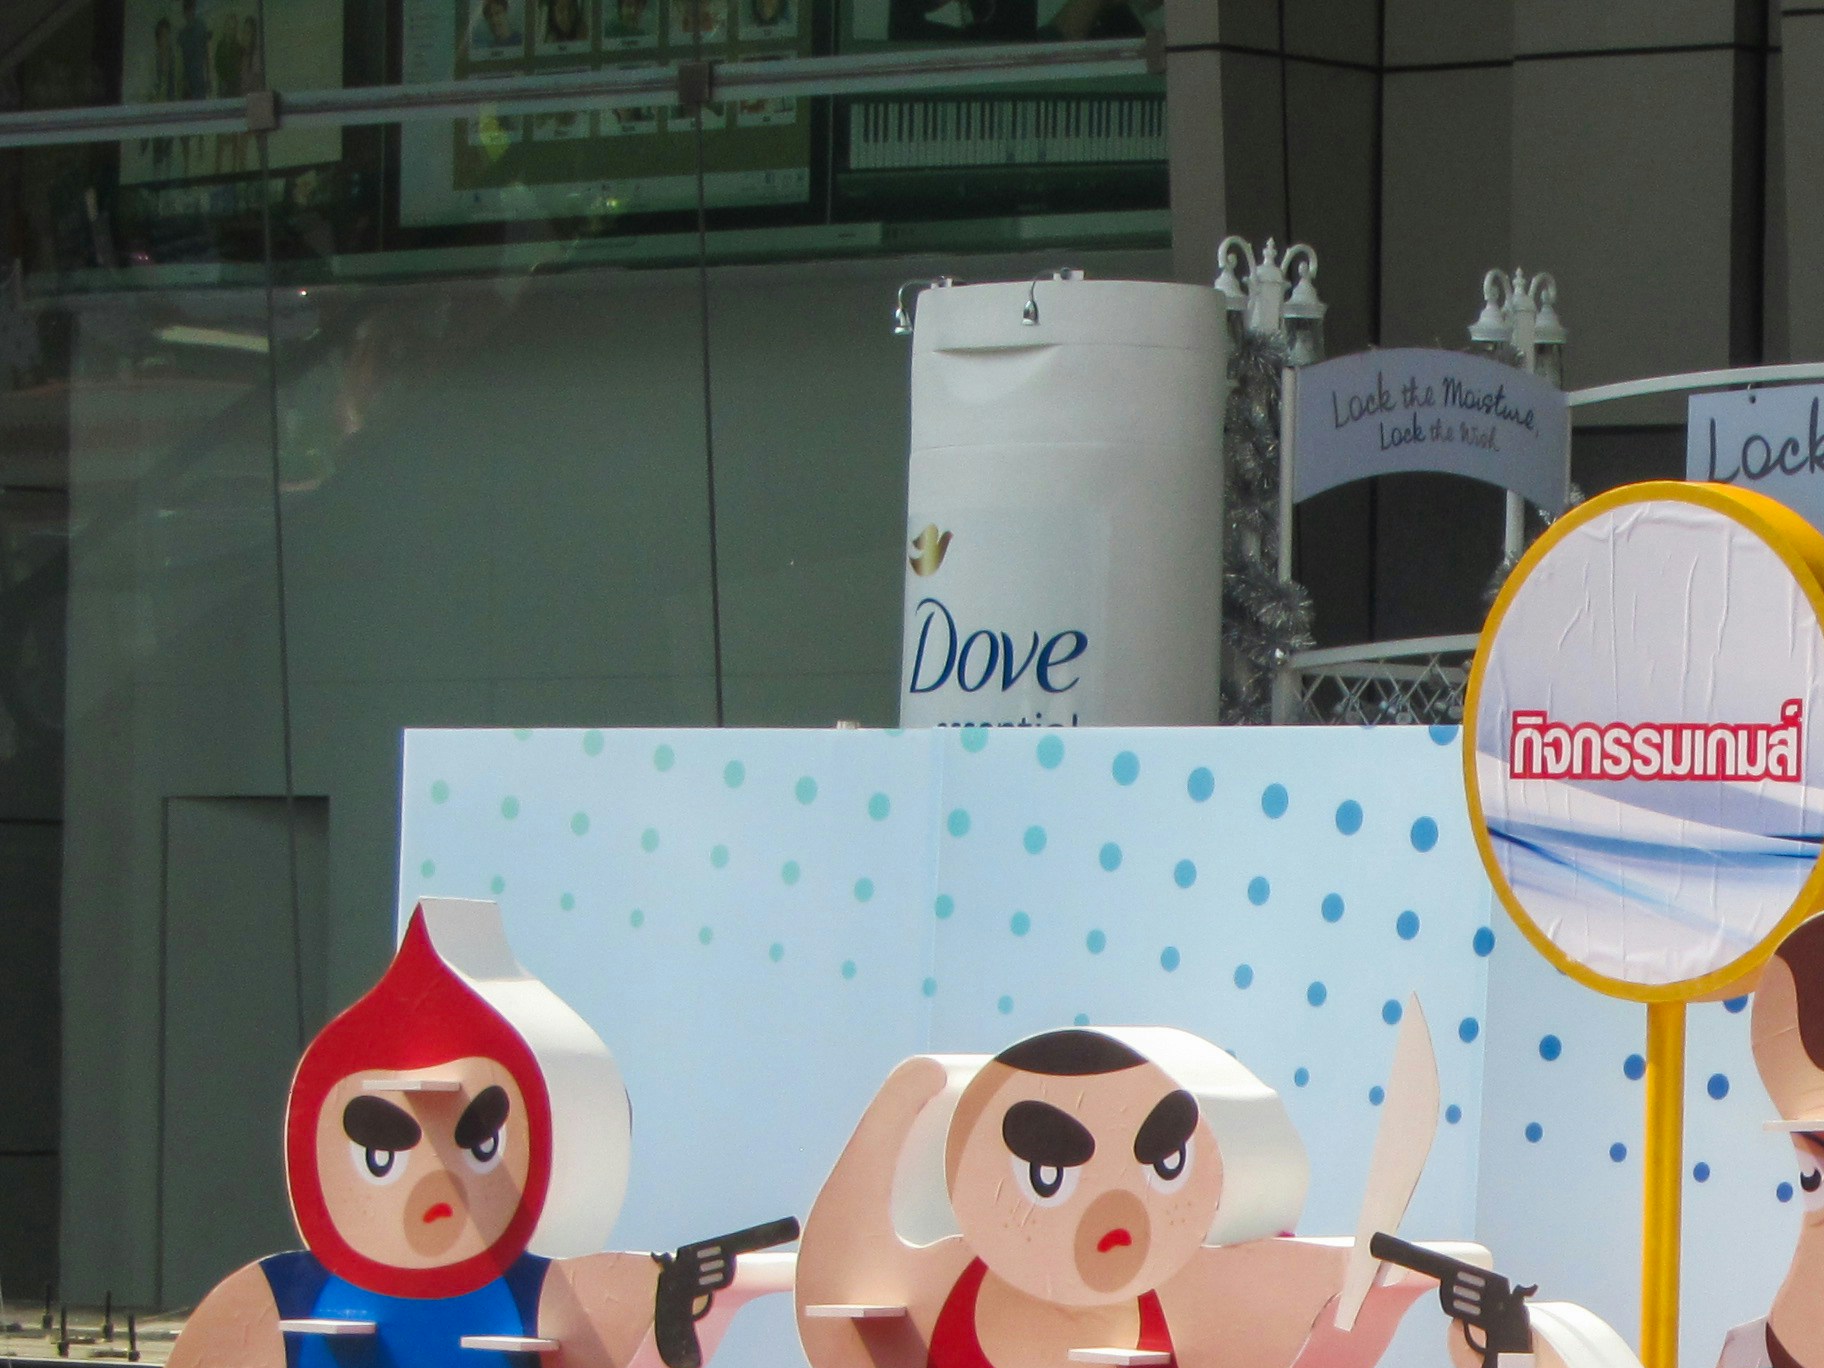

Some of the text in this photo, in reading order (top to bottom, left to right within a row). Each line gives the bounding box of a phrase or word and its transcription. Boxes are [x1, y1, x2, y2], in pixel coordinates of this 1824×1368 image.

[1332, 370, 1396, 429] Lock
[1402, 376, 1435, 409] the
[1380, 411, 1426, 450] Lock
[909, 597, 1088, 693] Dove
[1510, 698, 1803, 782] กิจกรรมเกมส์
